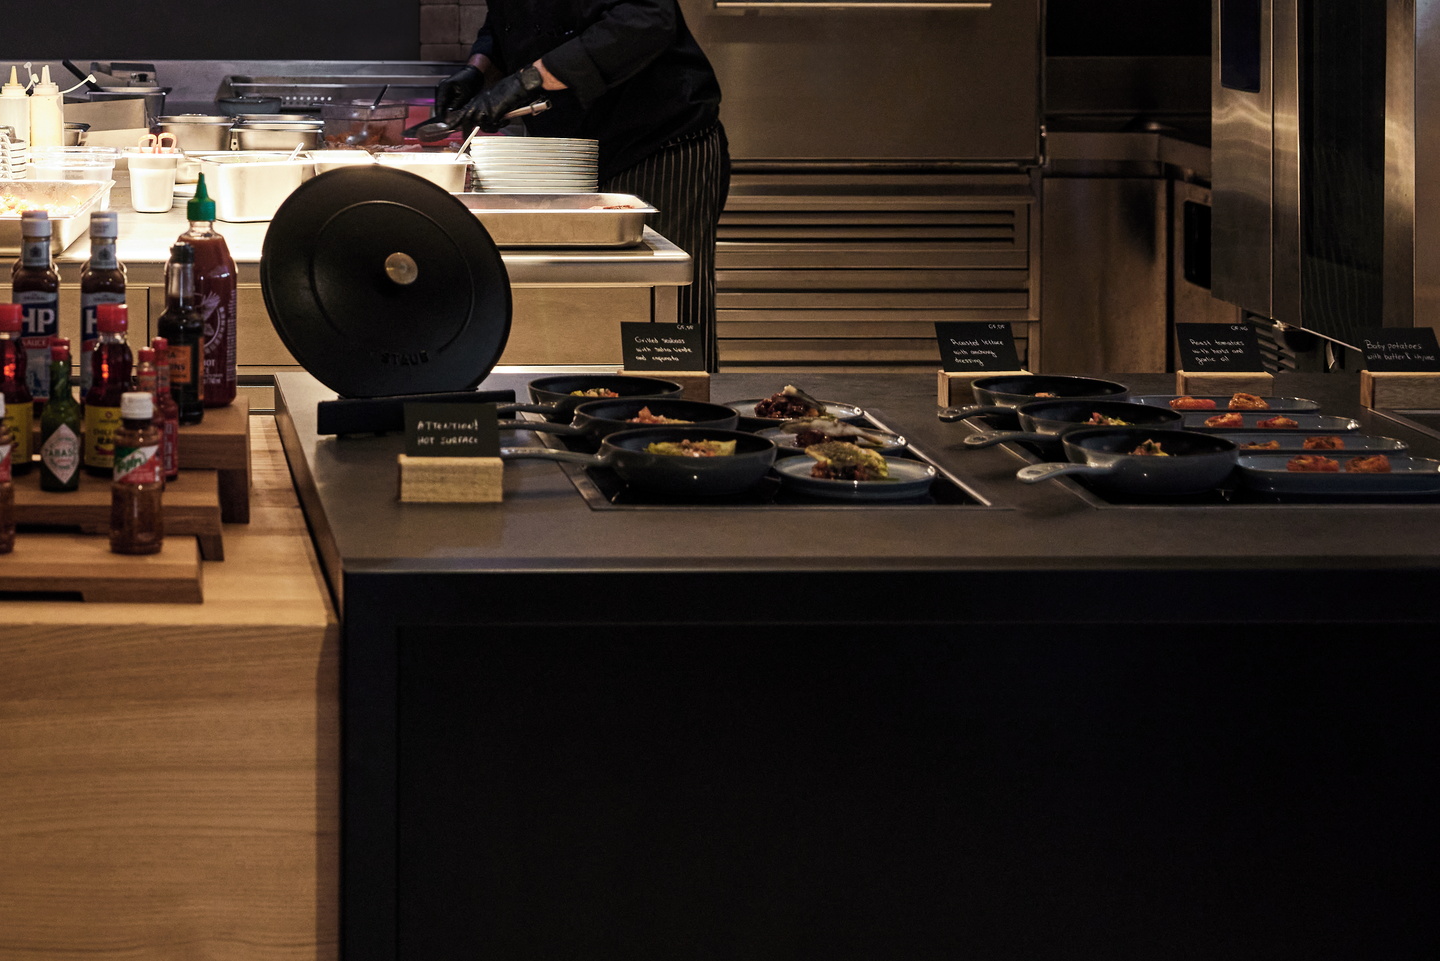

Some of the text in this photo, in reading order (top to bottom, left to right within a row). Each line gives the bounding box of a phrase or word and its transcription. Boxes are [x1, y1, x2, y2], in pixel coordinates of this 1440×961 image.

[1364, 339, 1422, 351] Baby potatoes
[1384, 352, 1404, 360] butter
[417, 437, 436, 446] HOT
